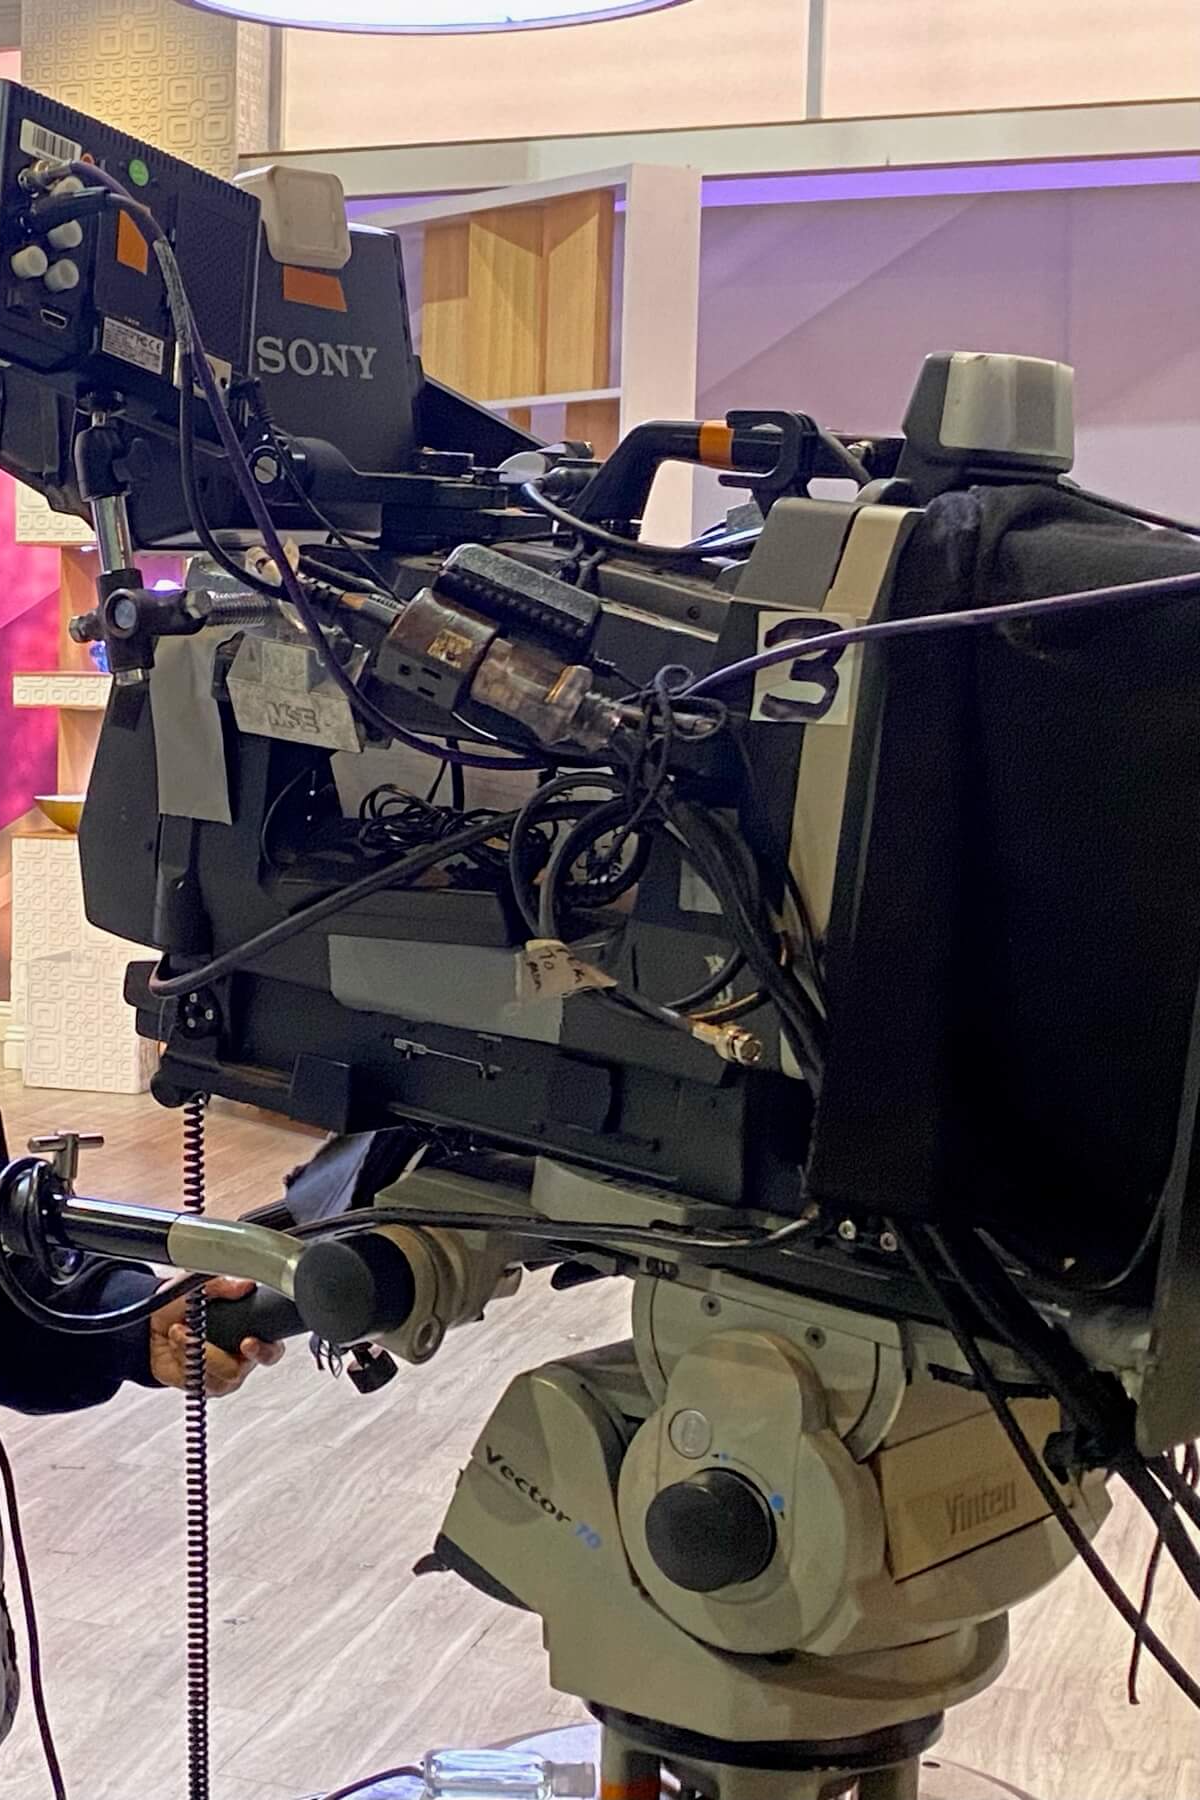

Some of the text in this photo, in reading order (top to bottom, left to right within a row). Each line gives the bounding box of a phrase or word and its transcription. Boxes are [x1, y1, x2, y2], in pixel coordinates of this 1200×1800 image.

[256, 335, 378, 379] SONY
[759, 617, 846, 721] 3
[485, 1443, 573, 1523] Vector
